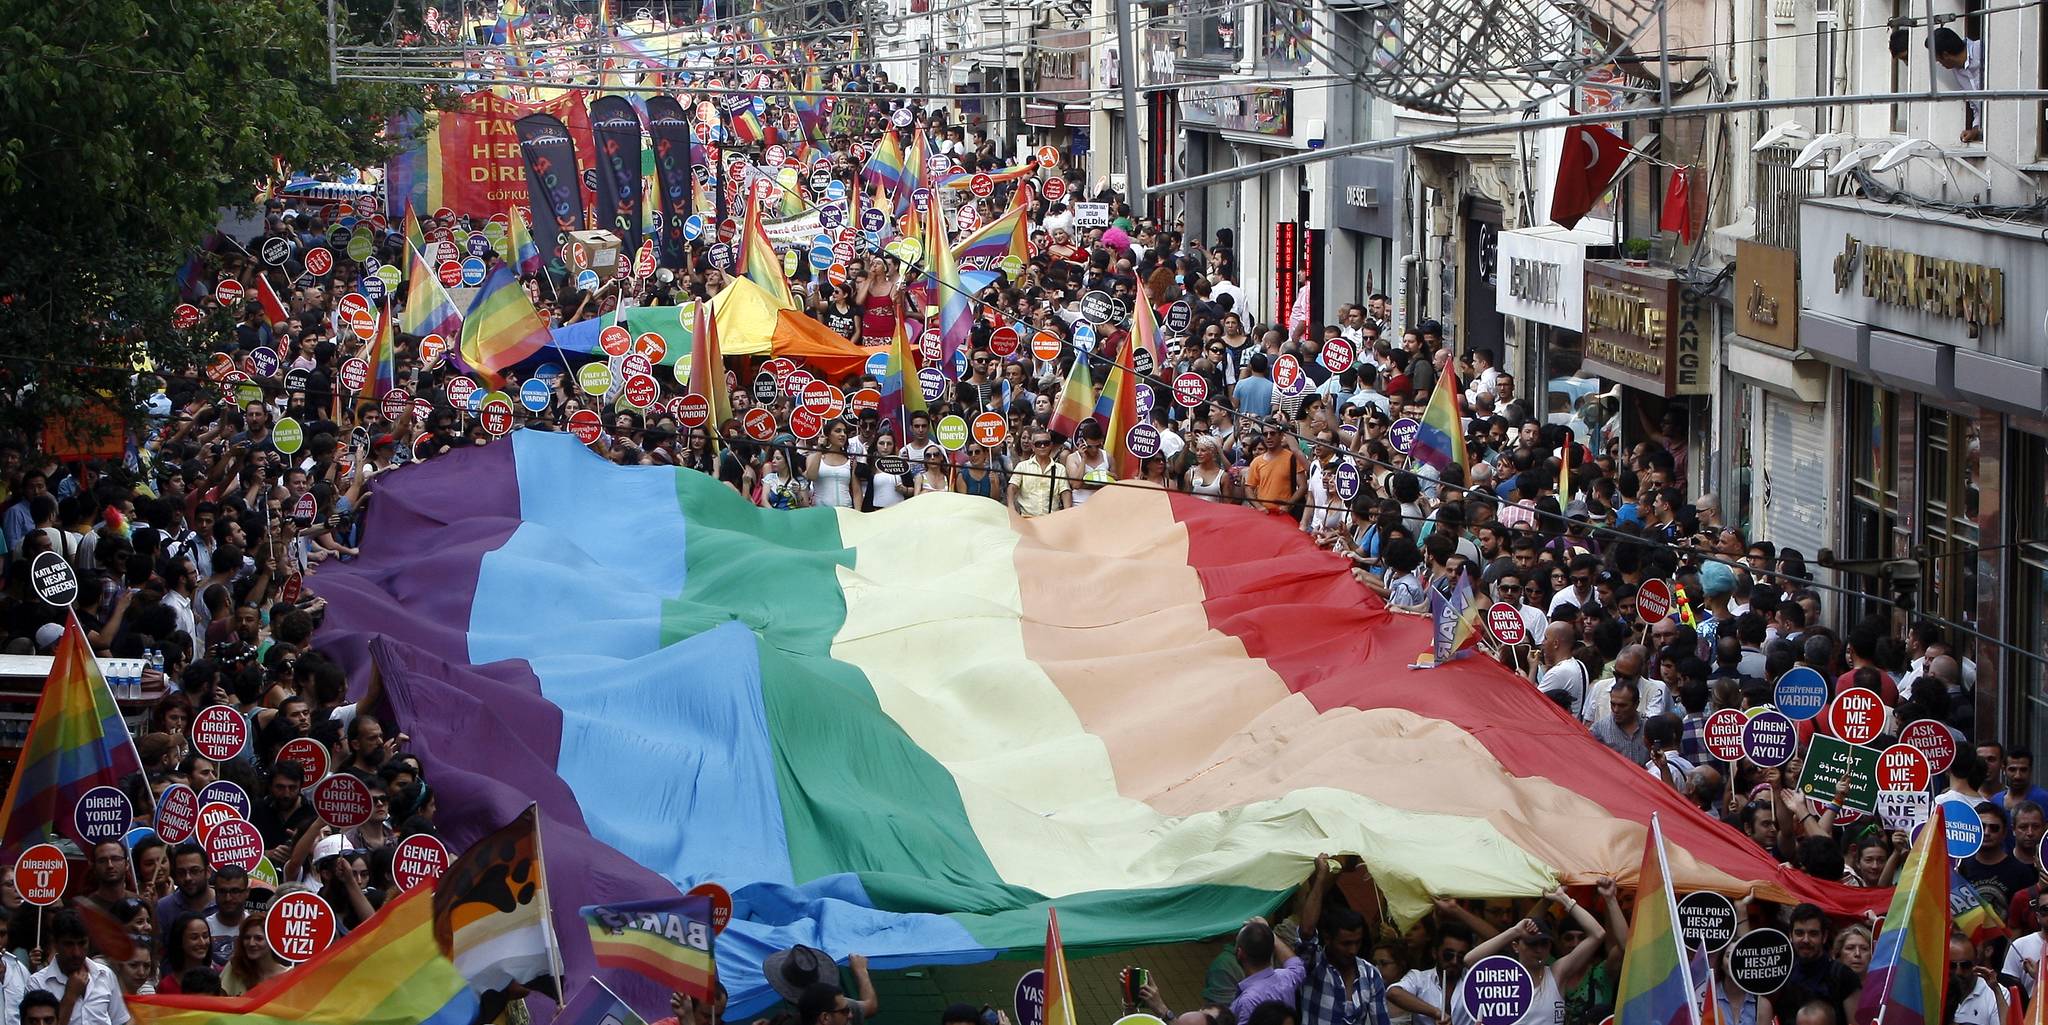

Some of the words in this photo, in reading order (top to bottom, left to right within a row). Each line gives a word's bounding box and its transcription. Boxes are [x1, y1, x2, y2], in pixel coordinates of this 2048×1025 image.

[1347, 186, 1368, 207] DIESEL
[1078, 217, 1106, 225] GELDİK
[1082, 307, 1109, 320] VERECEK!
[1087, 302, 1108, 313] HESAP
[1679, 288, 1699, 385] CHANGE
[1328, 342, 1349, 357] GENEL
[255, 351, 276, 365] YASAK
[1280, 359, 1296, 369] DÖN-
[1326, 351, 1349, 364] AHLAK-
[1279, 368, 1291, 377] ME-
[805, 397, 831, 406] VARDIR
[489, 415, 504, 423] ME-
[680, 410, 706, 418] VARDIR
[1134, 429, 1158, 438] DİRENİ-
[1392, 425, 1417, 436] YASAK
[1133, 436, 1155, 445] YORUZ
[1132, 444, 1153, 454] AYOL!
[1339, 471, 1356, 480] YASAK
[1342, 480, 1350, 488] NE
[43, 571, 67, 587] HESAP
[41, 579, 76, 597] VERECEK!
[1641, 588, 1669, 607] TRANSLAR
[1639, 599, 1666, 617] VARDIR
[1491, 610, 1517, 623] GENEL
[1494, 620, 1522, 631] AHLAK-
[1502, 630, 1518, 640] SIZ!
[1778, 685, 1823, 694] LEZBİYENLER
[1780, 695, 1821, 707] VARDIR
[1843, 696, 1876, 711] DÖN-
[1847, 712, 1871, 724] ME-
[201, 718, 240, 733] ÖRGÜT-
[1753, 719, 1790, 733] DİRENİ-
[1844, 725, 1869, 739] YİZ!
[197, 733, 243, 745] LENMEK-
[1709, 737, 1742, 747] LENME
[1752, 733, 1787, 745] YORUZ
[207, 744, 228, 757] TİR!
[1719, 747, 1739, 757] TİR!
[1752, 746, 1785, 759] AYOL!
[1833, 752, 1861, 766] LGBT
[1886, 752, 1919, 767] DÖN-
[1819, 762, 1867, 780] öğrenimin
[1890, 769, 1915, 781] ME-
[207, 789, 244, 803] DİRENİ-
[322, 789, 367, 801] ÖRGÜT-
[1879, 794, 1927, 804] YASAK
[86, 795, 124, 809] DİRENİ-
[319, 802, 368, 814] LENMEK-
[86, 810, 122, 822] YORUZ
[203, 809, 233, 826] DÖN-
[330, 813, 353, 823] TİR!
[1888, 806, 1916, 817] NE
[159, 811, 192, 832] LENMEK-
[86, 823, 121, 838] AYOL!
[162, 827, 179, 841] TİR!
[213, 834, 255, 850] ÖRGÜT-
[212, 848, 260, 863] LENMEK-
[403, 845, 440, 863] GENEL
[400, 860, 443, 878] AHLAK-
[281, 900, 324, 919] DÖN-
[1680, 906, 1704, 916] KATIL
[1705, 907, 1730, 916] POLIS
[285, 921, 317, 936] ME-
[1687, 916, 1723, 928] HESAP
[281, 936, 313, 954] YİZ!
[1736, 948, 1758, 957] KATIL
[1760, 944, 1787, 956] DEVLET
[1744, 955, 1781, 968] HESAP
[1476, 970, 1522, 984] DİRENİ-
[1736, 965, 1787, 980] VERECEK!
[1476, 986, 1519, 999] YORUZ
[1478, 1001, 1518, 1017] AYOL!
